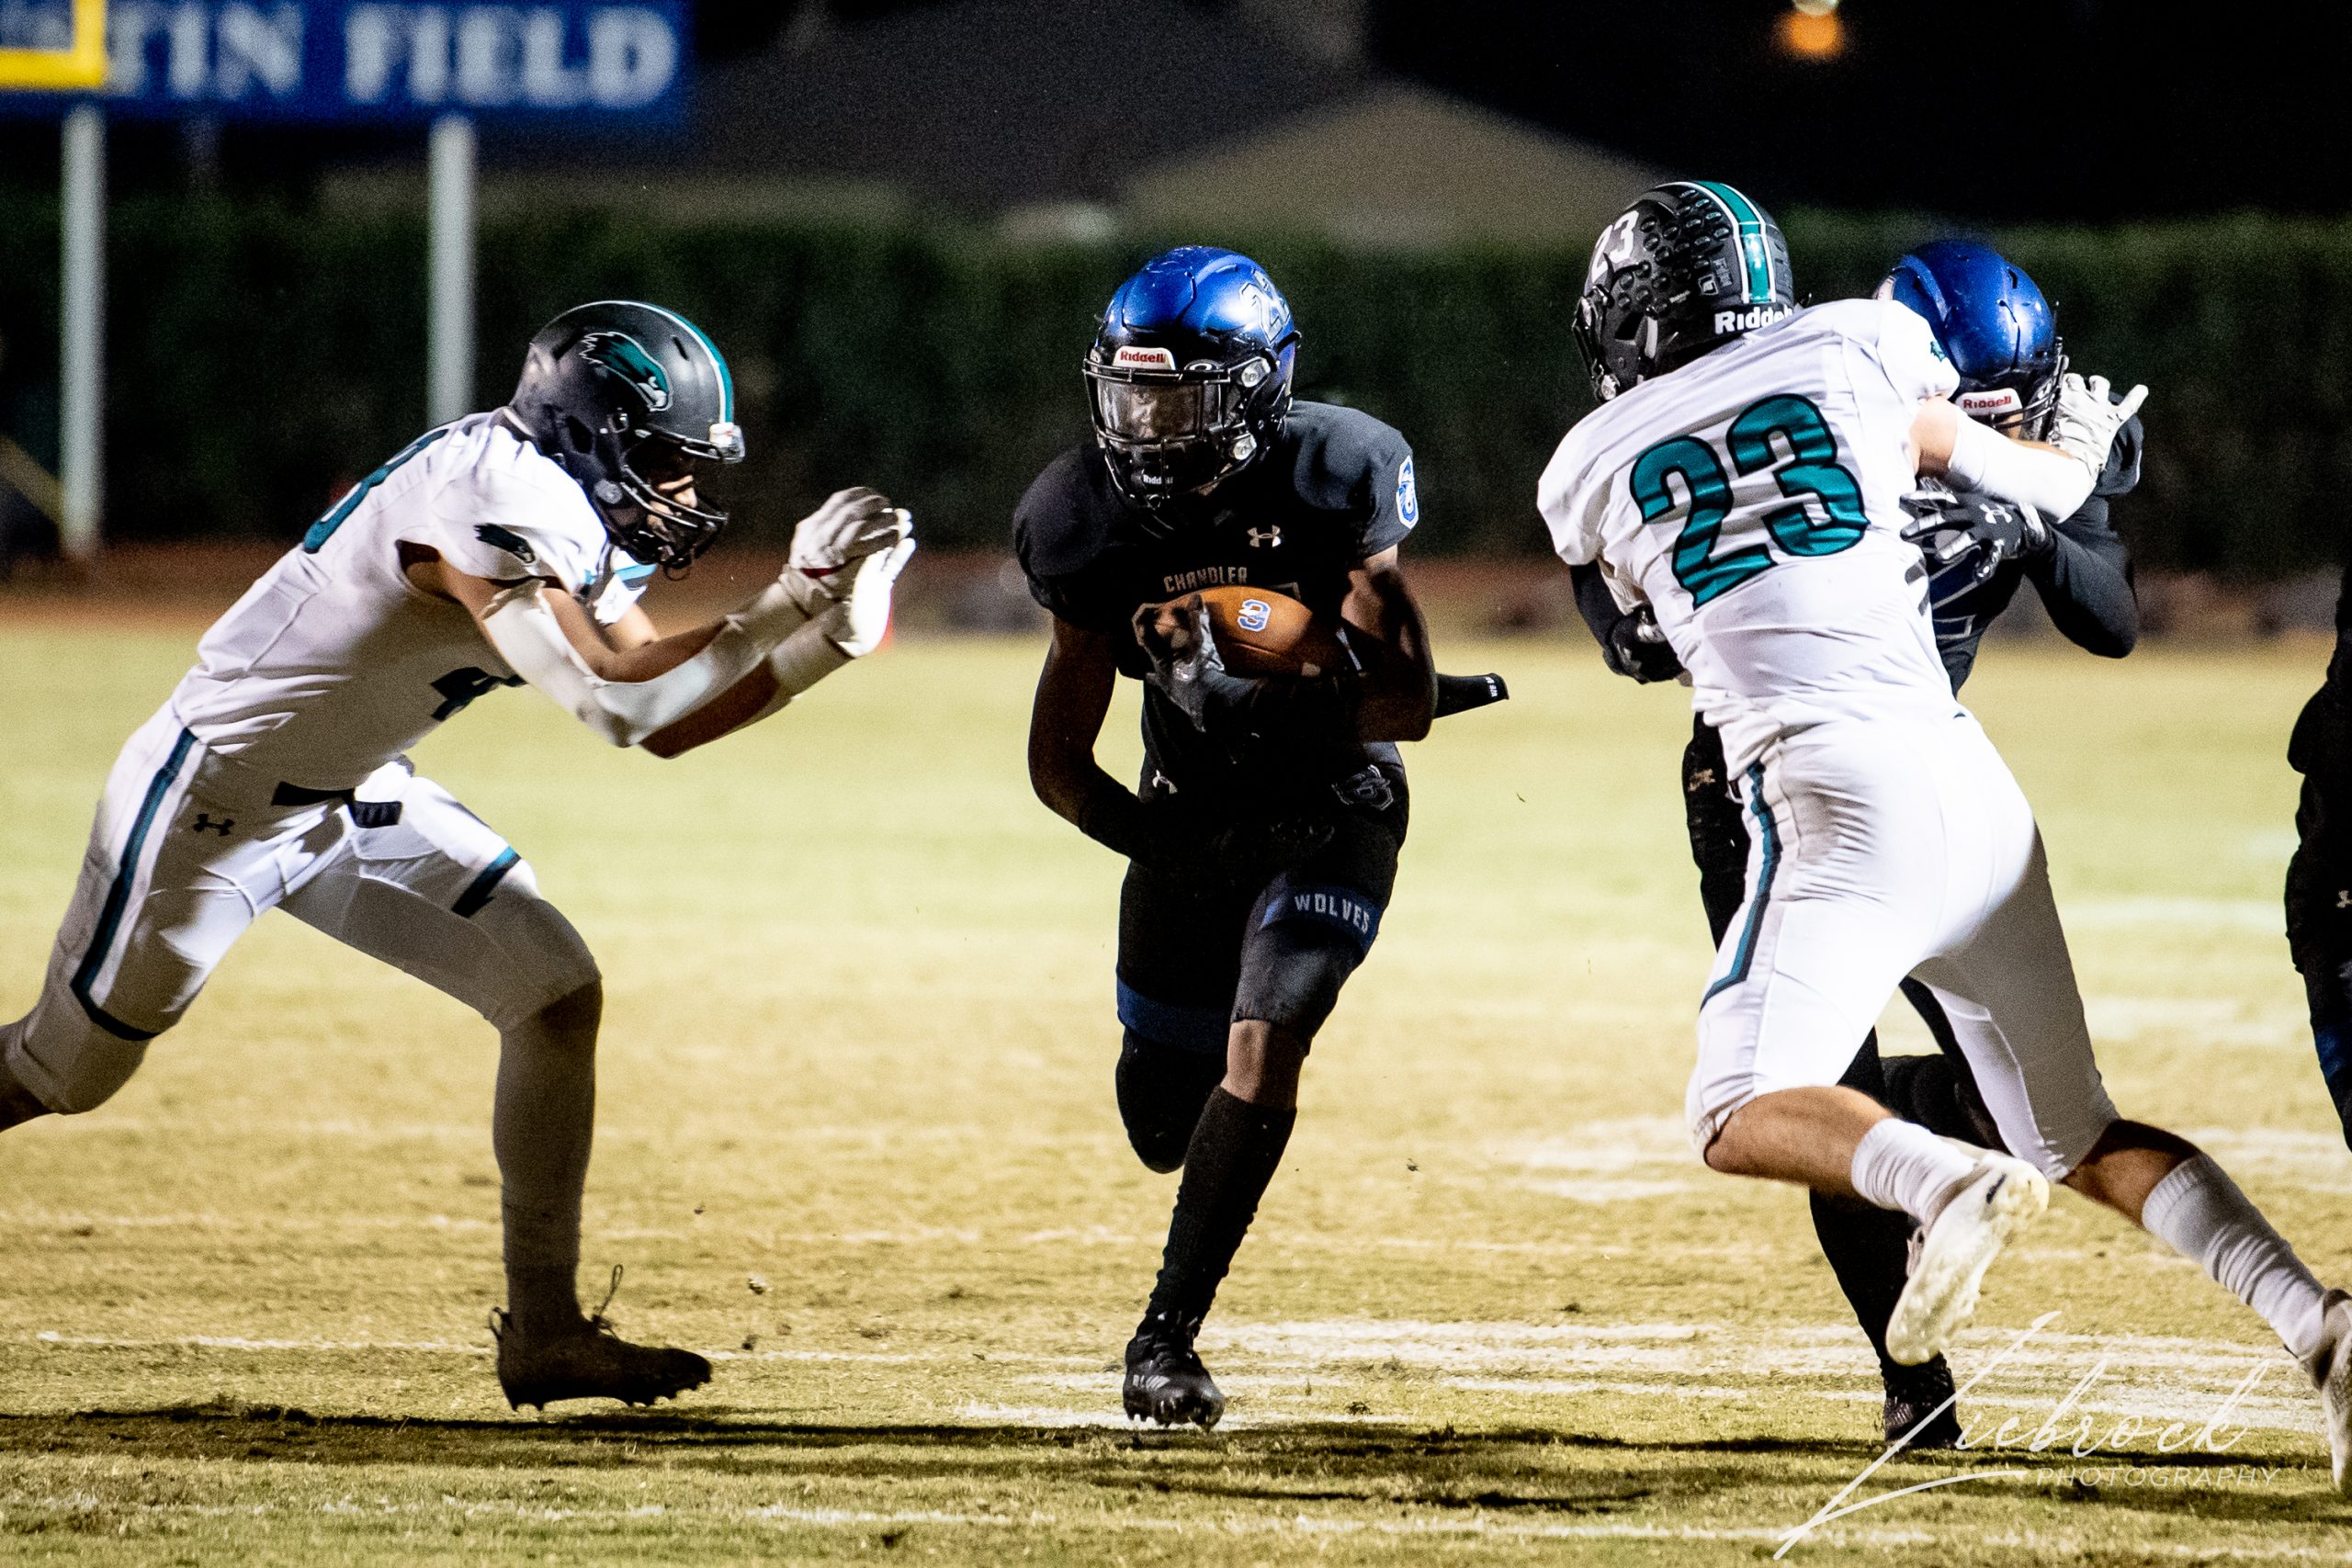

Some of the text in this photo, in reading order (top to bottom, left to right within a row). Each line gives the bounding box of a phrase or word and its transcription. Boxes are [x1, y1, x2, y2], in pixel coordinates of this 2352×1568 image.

[37, 2, 681, 107] TIN FIELD
[1591, 210, 1639, 283] 23
[1120, 351, 1165, 364] Riddell
[1962, 396, 2012, 410] Riddell
[1629, 392, 1871, 611] 23
[1163, 566, 1248, 593] CHANDLER
[1295, 893, 1370, 934] WOLVES
